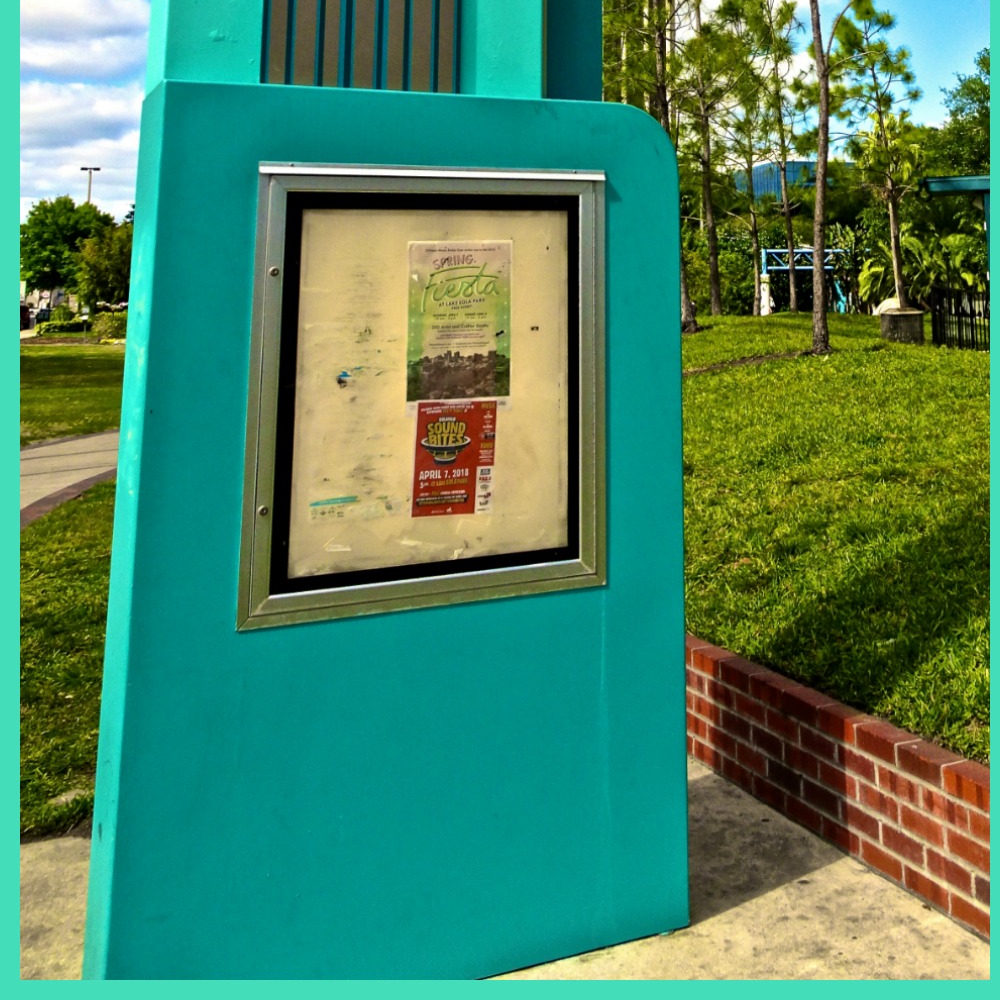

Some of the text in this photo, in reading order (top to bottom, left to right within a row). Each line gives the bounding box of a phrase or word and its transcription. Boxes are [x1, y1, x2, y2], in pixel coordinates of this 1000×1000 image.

[421, 262, 500, 313] Fiesta
[427, 422, 466, 435] SOUND
[428, 434, 464, 446] BITES
[419, 470, 442, 480] APRIL
[452, 468, 469, 478] 2018
